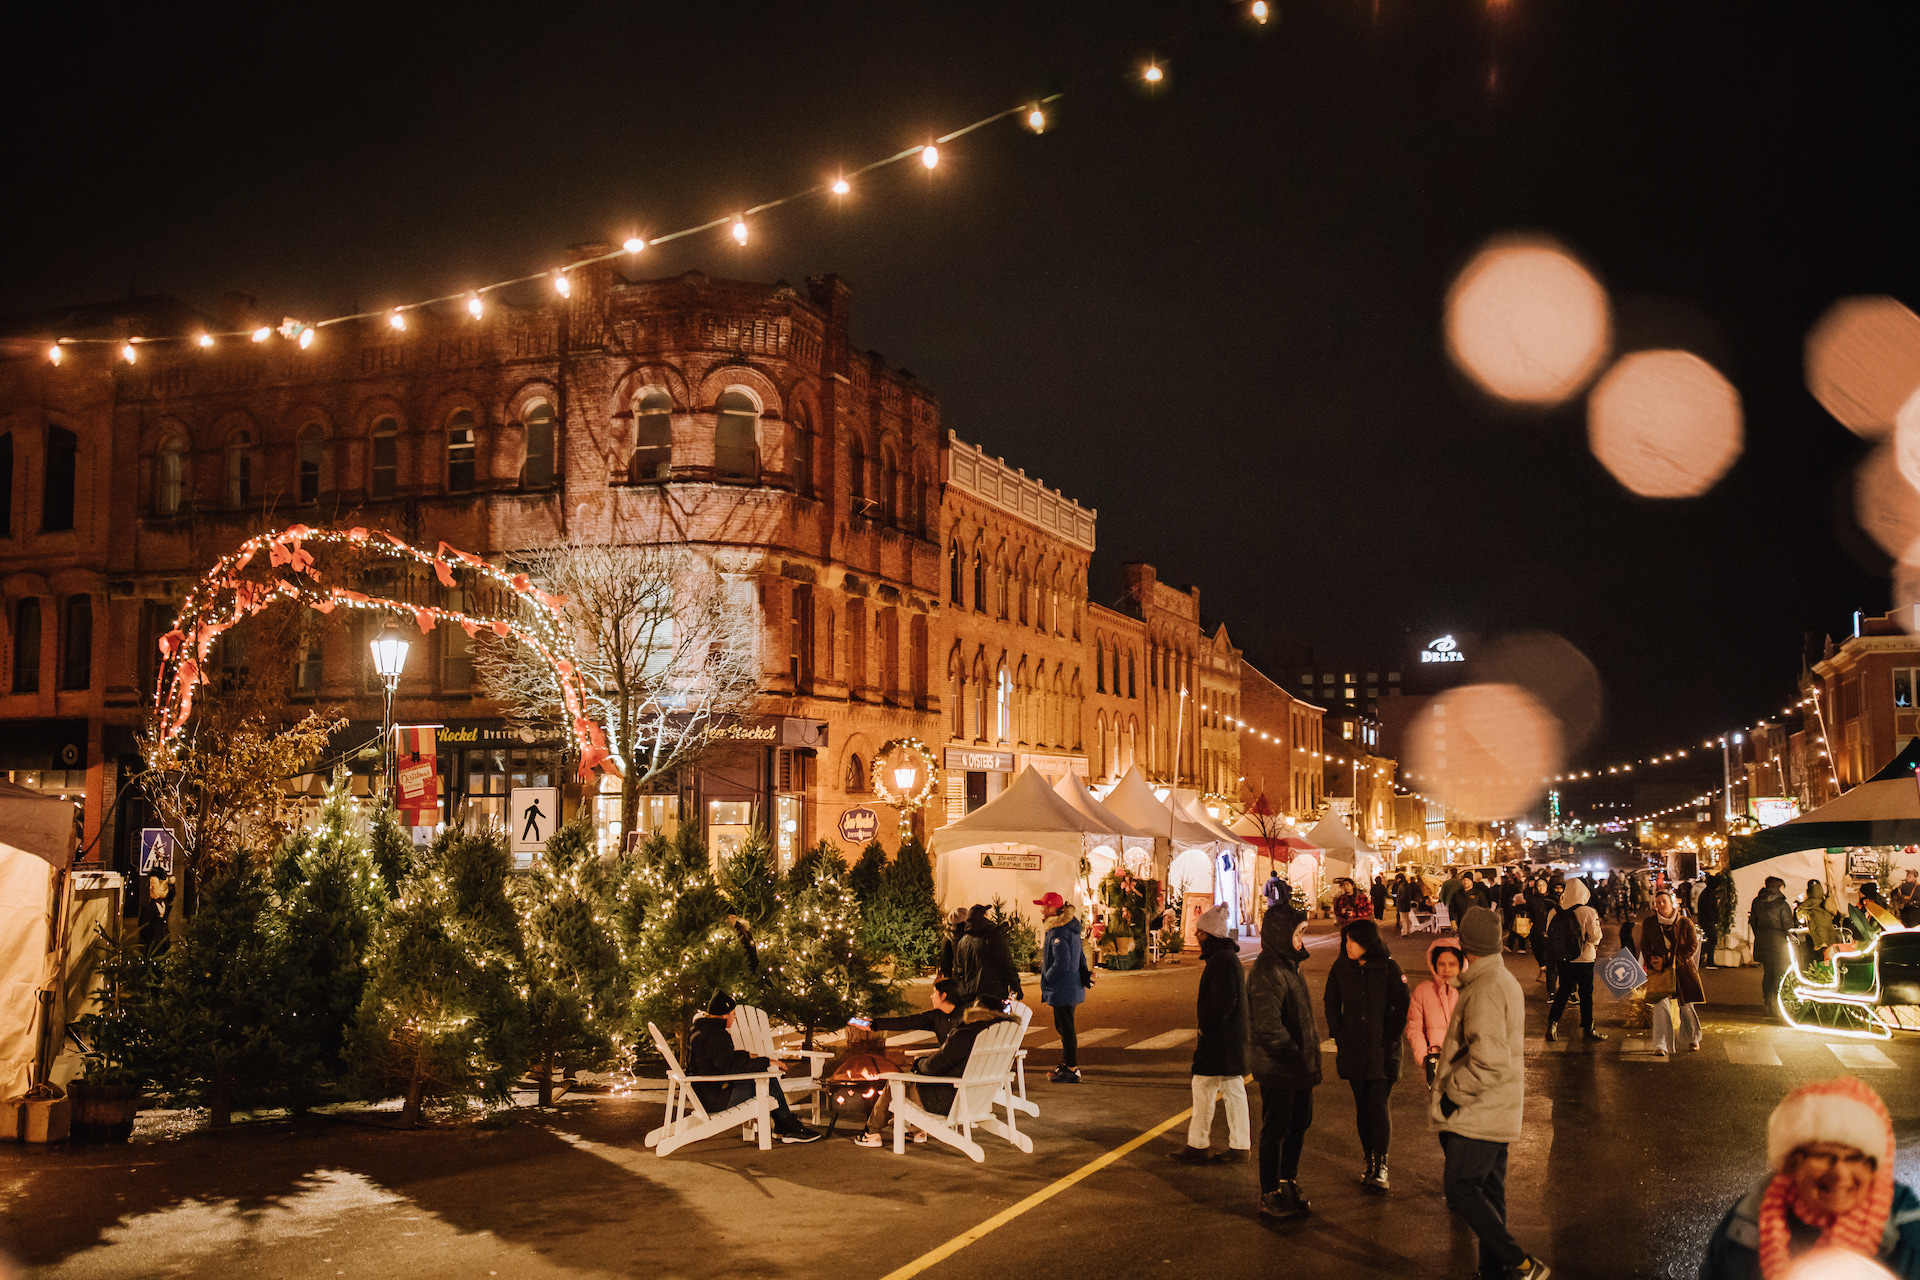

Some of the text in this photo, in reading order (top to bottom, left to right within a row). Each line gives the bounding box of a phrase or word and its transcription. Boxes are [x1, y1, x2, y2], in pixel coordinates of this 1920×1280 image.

[1421, 650, 1465, 662] DELTA
[438, 726, 478, 742] Rocket
[483, 729, 518, 740] OYSTER
[969, 753, 994, 769] OYSTERS
